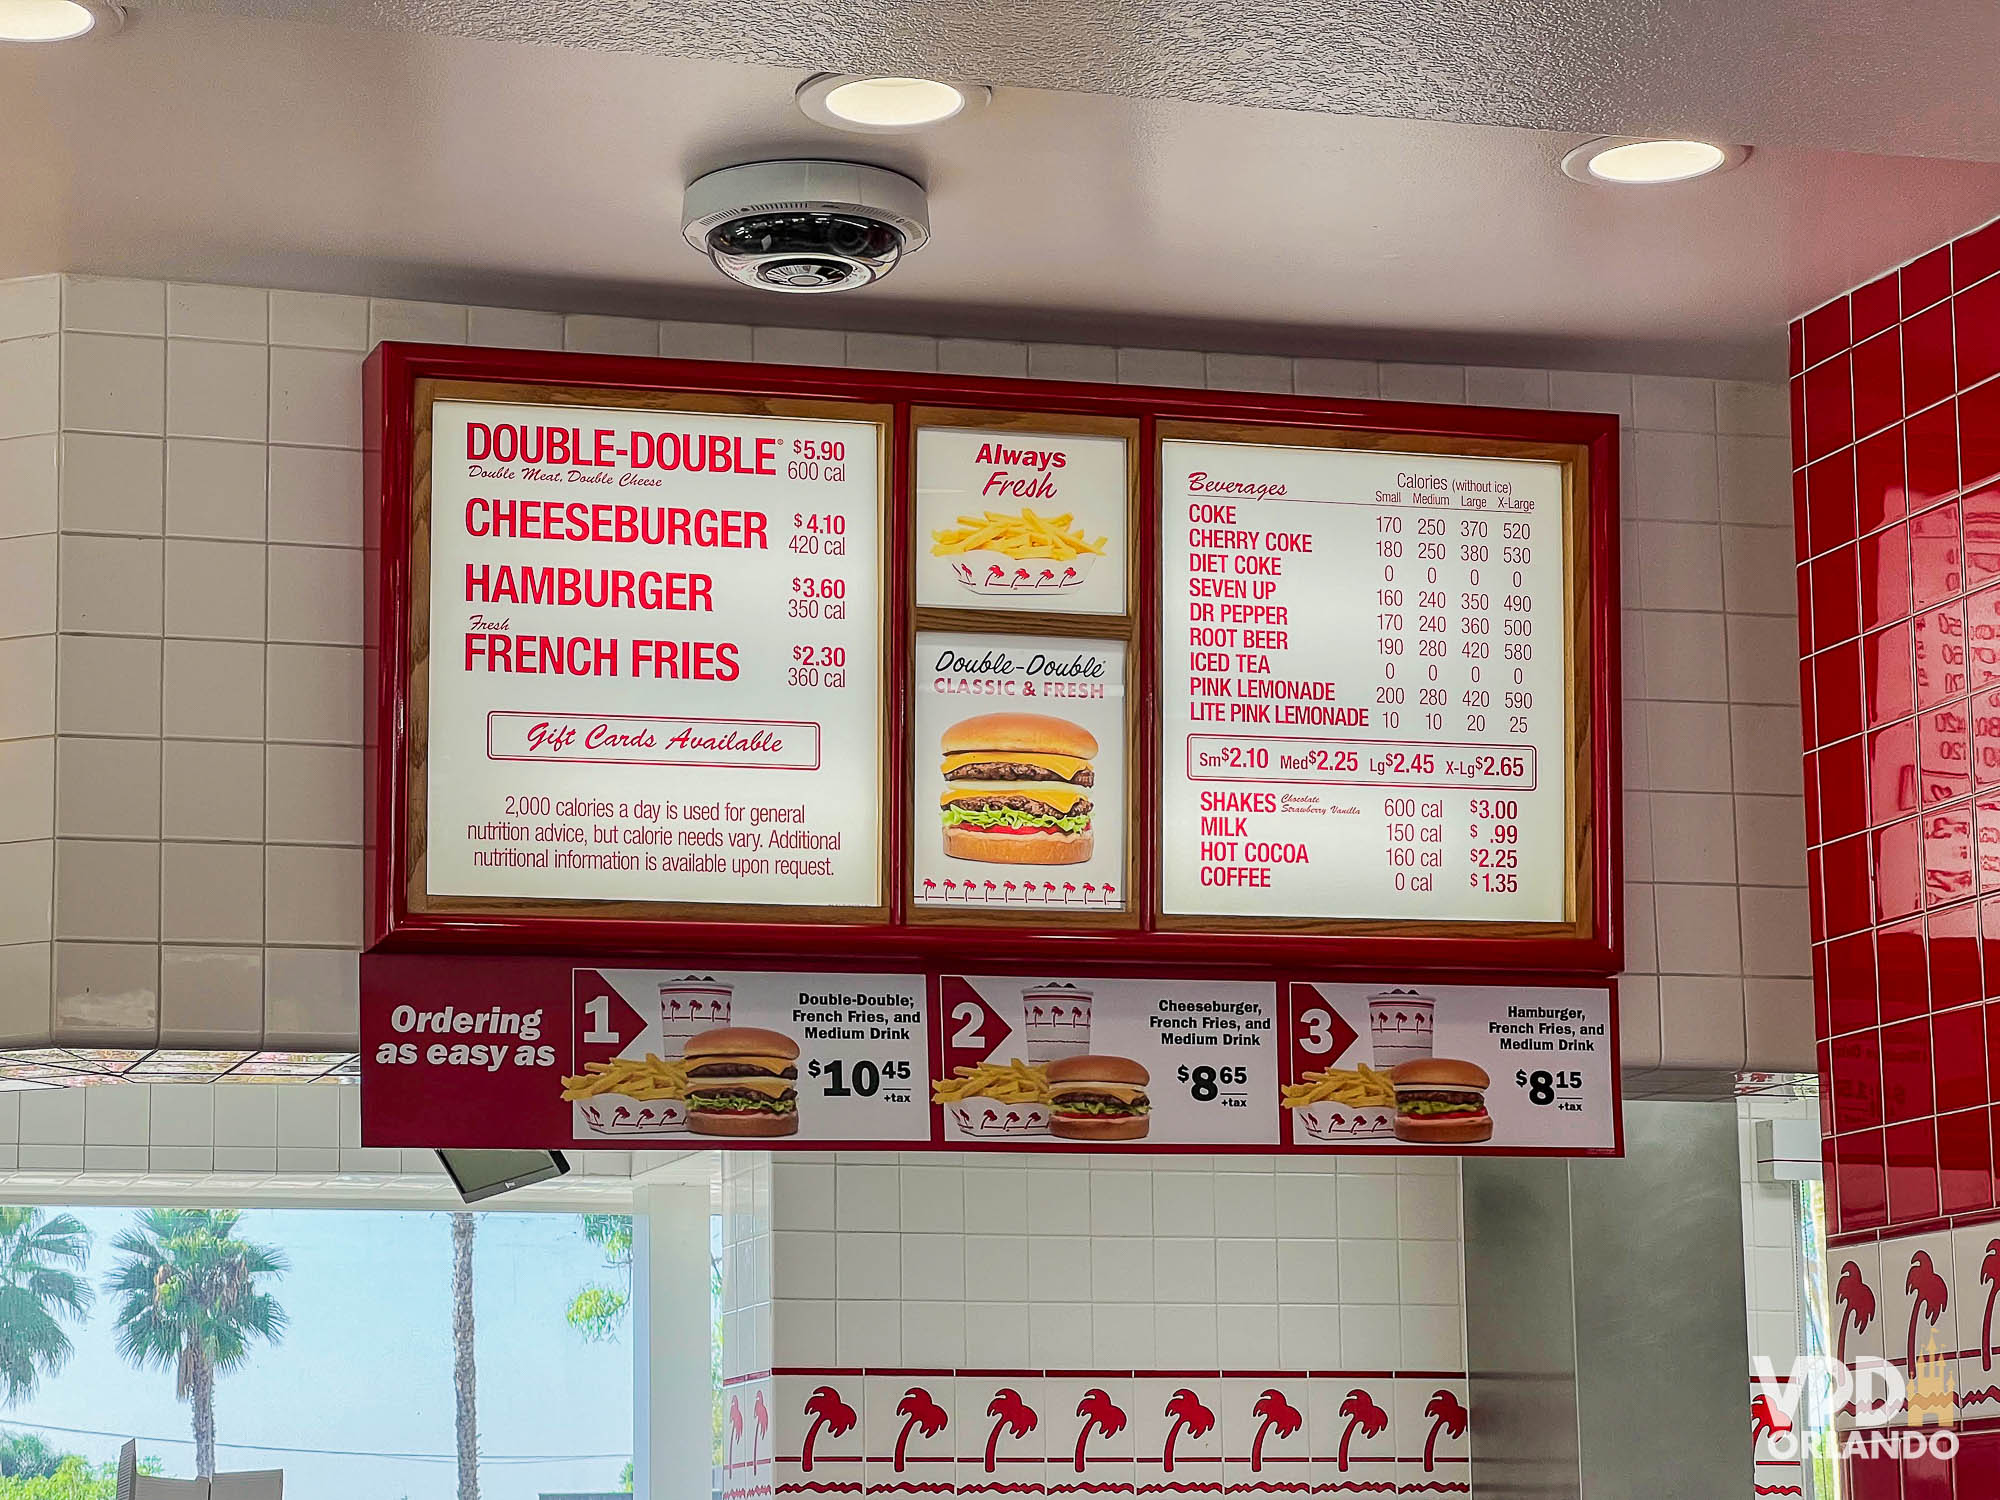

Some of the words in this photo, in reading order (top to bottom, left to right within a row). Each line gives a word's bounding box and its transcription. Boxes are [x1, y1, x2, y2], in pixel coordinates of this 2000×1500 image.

[792, 438, 846, 462] $5.90
[975, 443, 1067, 472] Always
[468, 464, 516, 480] Double
[567, 470, 614, 484] Double
[618, 472, 662, 487] Cheese
[787, 461, 819, 481] 600
[821, 464, 846, 483] cal
[1397, 472, 1448, 491] Calories
[1452, 479, 1492, 493] (without
[1494, 482, 1512, 494] ice)
[982, 471, 1058, 499] Fresh
[1188, 471, 1288, 501] Beverages
[1375, 491, 1402, 503] Small
[1412, 493, 1450, 506] Medium
[1461, 496, 1487, 510] Large
[1498, 497, 1535, 512] X-Large
[464, 497, 769, 550] CHEESEBURGER
[793, 512, 846, 536] $4.10
[1188, 503, 1237, 525] COKE
[1375, 516, 1402, 534] 170
[1417, 518, 1446, 536] 250
[1460, 520, 1488, 538] 370
[1503, 522, 1531, 540] 520
[788, 535, 819, 555] 420
[823, 537, 846, 557] cal
[1189, 528, 1260, 550] CHERRY
[1265, 532, 1313, 553] COKE
[1375, 540, 1403, 558] 180
[1418, 542, 1446, 560] 250
[1460, 544, 1489, 563] 380
[1503, 546, 1531, 565] 530
[1189, 553, 1228, 573] DIET
[1234, 555, 1282, 576] COKE
[464, 563, 714, 612] HAMBURGER
[791, 577, 846, 600] $3.60
[1189, 577, 1247, 599] SEVEN
[1253, 580, 1276, 600] UP
[787, 599, 819, 619] 350
[823, 602, 846, 621] cal
[1376, 589, 1403, 607] 160
[1418, 591, 1446, 609] 240
[1461, 593, 1489, 611] 350
[1504, 594, 1532, 613] 490
[469, 614, 511, 633] Fresh
[1190, 602, 1214, 622] DR
[1220, 604, 1288, 626] PEPPER
[1377, 613, 1403, 631] 170
[1419, 615, 1446, 633] 240
[1461, 617, 1490, 635] 360
[1504, 619, 1532, 637] 500
[1190, 627, 1237, 648] ROOT
[1243, 629, 1289, 650] BEER
[1377, 638, 1404, 656] 190
[1419, 639, 1447, 657] 280
[1461, 641, 1490, 659] 420
[1504, 643, 1532, 661] 580
[464, 632, 618, 677] FRENCH
[631, 639, 740, 682] FRIES
[792, 644, 846, 668] $2.30
[1190, 652, 1230, 672] ICED
[1235, 653, 1271, 674] TEA
[787, 667, 819, 687] 360
[822, 670, 846, 689] cal
[934, 677, 1015, 696] CLASSIC
[1022, 680, 1037, 697] &
[1043, 681, 1104, 699] FRESH
[1190, 676, 1232, 697] PINK
[1238, 679, 1335, 701] LEMONADE
[1376, 686, 1405, 705] 200
[1419, 688, 1447, 706] 280
[1462, 690, 1490, 708] 420
[1504, 692, 1533, 710] 590
[1190, 701, 1226, 722] LITE
[1230, 703, 1270, 724] PINK
[1275, 704, 1369, 727] LEMONADE
[526, 721, 576, 752] Gift
[584, 723, 657, 751] Cards
[664, 727, 784, 754] Available
[1200, 790, 1277, 813] SHAKES
[1281, 793, 1320, 804] Chocolate
[1281, 803, 1327, 816] Strawberry
[1330, 805, 1361, 815] Vanilla
[1384, 798, 1416, 818] 600
[1421, 799, 1443, 818] cal
[1469, 799, 1518, 820] $3.00
[504, 795, 551, 818] 2,000
[555, 798, 615, 819] calories
[633, 799, 661, 824] day
[665, 801, 678, 820] is
[682, 802, 720, 821] used
[724, 803, 746, 822] for
[749, 803, 806, 826] general
[466, 821, 531, 842] nutrition
[534, 823, 587, 845] advice,
[593, 824, 619, 845] but
[622, 826, 674, 845] calorie
[677, 827, 724, 847] needs
[727, 832, 764, 851] vary.
[768, 829, 842, 851] Additional
[1201, 816, 1248, 838] MILK
[1386, 823, 1415, 843] 150
[1420, 823, 1442, 843] cal
[473, 848, 549, 869] nutritional
[553, 849, 640, 871] information
[644, 852, 658, 872] is
[661, 853, 727, 873] available
[731, 858, 770, 878] upon
[774, 858, 835, 878] request.
[1200, 841, 1239, 862] HOT
[1244, 842, 1310, 864] COCOA
[1385, 847, 1415, 867] 160
[1420, 848, 1442, 868] cal
[1469, 848, 1518, 869] $2.25
[1200, 866, 1271, 888] COFFEE
[1395, 872, 1405, 892] 0
[1411, 873, 1433, 892] cal
[1469, 873, 1518, 893] $1.35
[792, 1009, 843, 1023] French
[848, 1010, 889, 1025] Fries,
[893, 1011, 921, 1023] and
[1158, 999, 1263, 1016] Cheeseburger,
[1507, 1006, 1586, 1022] Hamburger,
[391, 1004, 543, 1041] Ordering
[583, 995, 620, 1044] 1
[951, 1001, 986, 1048] 2
[1150, 1016, 1198, 1029] French
[1202, 1016, 1241, 1032] Fries,
[1244, 1017, 1271, 1030] and
[1488, 1022, 1536, 1035] French
[1538, 1023, 1576, 1037] Fries,
[1579, 1024, 1605, 1036] and
[804, 1026, 865, 1040] Medium
[870, 1027, 910, 1040] Drink
[1161, 1032, 1218, 1046] Medium
[1222, 1033, 1261, 1047] Drink
[1298, 1008, 1334, 1055] 3
[1500, 1038, 1554, 1051] Medium
[1558, 1039, 1595, 1052] Drink
[375, 1042, 418, 1065] as
[426, 1043, 509, 1072] easy
[513, 1045, 556, 1067] as
[884, 1093, 911, 1103] +tax
[1221, 1097, 1248, 1108] +tax
[1557, 1102, 1583, 1112] +tax
